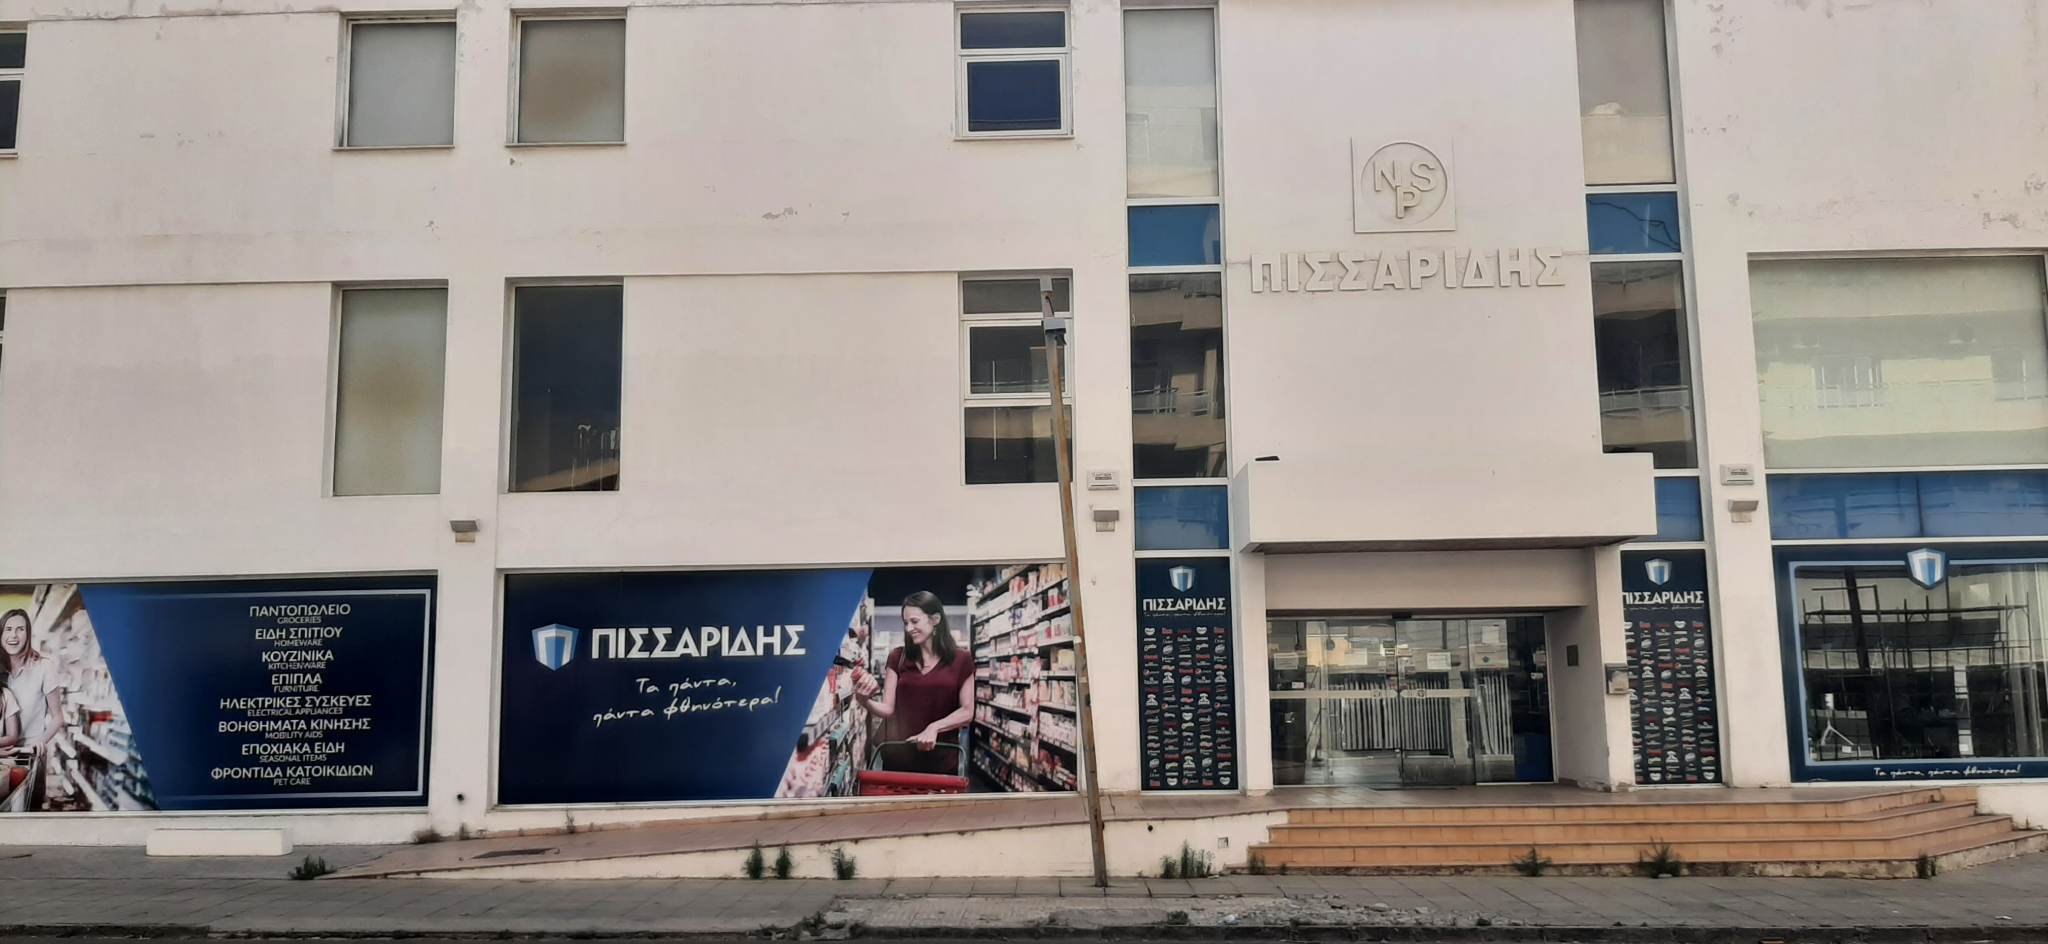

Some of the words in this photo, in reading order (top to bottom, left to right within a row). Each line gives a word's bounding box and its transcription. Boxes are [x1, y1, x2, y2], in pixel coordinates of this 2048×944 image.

[1250, 248, 1566, 293] ΠΙΣΣΑΡΙΔΗΣ
[249, 603, 351, 617] ΠΑΝΤΟΠΩΛΕΙΟ
[1142, 597, 1227, 611] ΠΙΣΣΑΡΙΔΗΣ
[277, 616, 322, 624] GROCERIES
[255, 628, 286, 640] ΕΙΔΗ
[289, 626, 343, 639] ΣΠΙΤΙΟΥ
[273, 638, 323, 647] HOMEWARE
[591, 624, 806, 660] ΠΙΣΣΑΡΙΔΗΣ
[261, 649, 334, 663] ΚΟΥΖΙΝΙΚΑ
[271, 673, 323, 686] ΕΠΙΠΛΑ
[635, 677, 660, 694] Τα
[273, 685, 320, 693] FURNITURE
[219, 697, 302, 710] ΗΛΕΚΤΡΙΚΕΣ
[304, 695, 372, 707] ΣΥΣΚΕΥΕΣ
[247, 708, 293, 717] ELECTRICAL
[294, 707, 343, 716] APPLIANCES
[218, 719, 307, 732] ΒΟΗΘΗΜΑΤΑ
[310, 718, 372, 730] ΚΙΝΗΣΗΣ
[265, 731, 304, 739] MOBILITY
[241, 743, 311, 755] ΕΠΟΧΙΑΚΑ
[314, 742, 345, 753] ΕΙΔΗ
[259, 754, 301, 763] SEASONAL
[302, 753, 327, 762] ITEMS
[210, 767, 283, 780] ΦΡΟΝΤΙΔΑ
[286, 765, 374, 777] ΚΑΤΟΙΚΙΔΙΩΝ
[273, 778, 288, 786] PET
[289, 777, 311, 785] CARE
